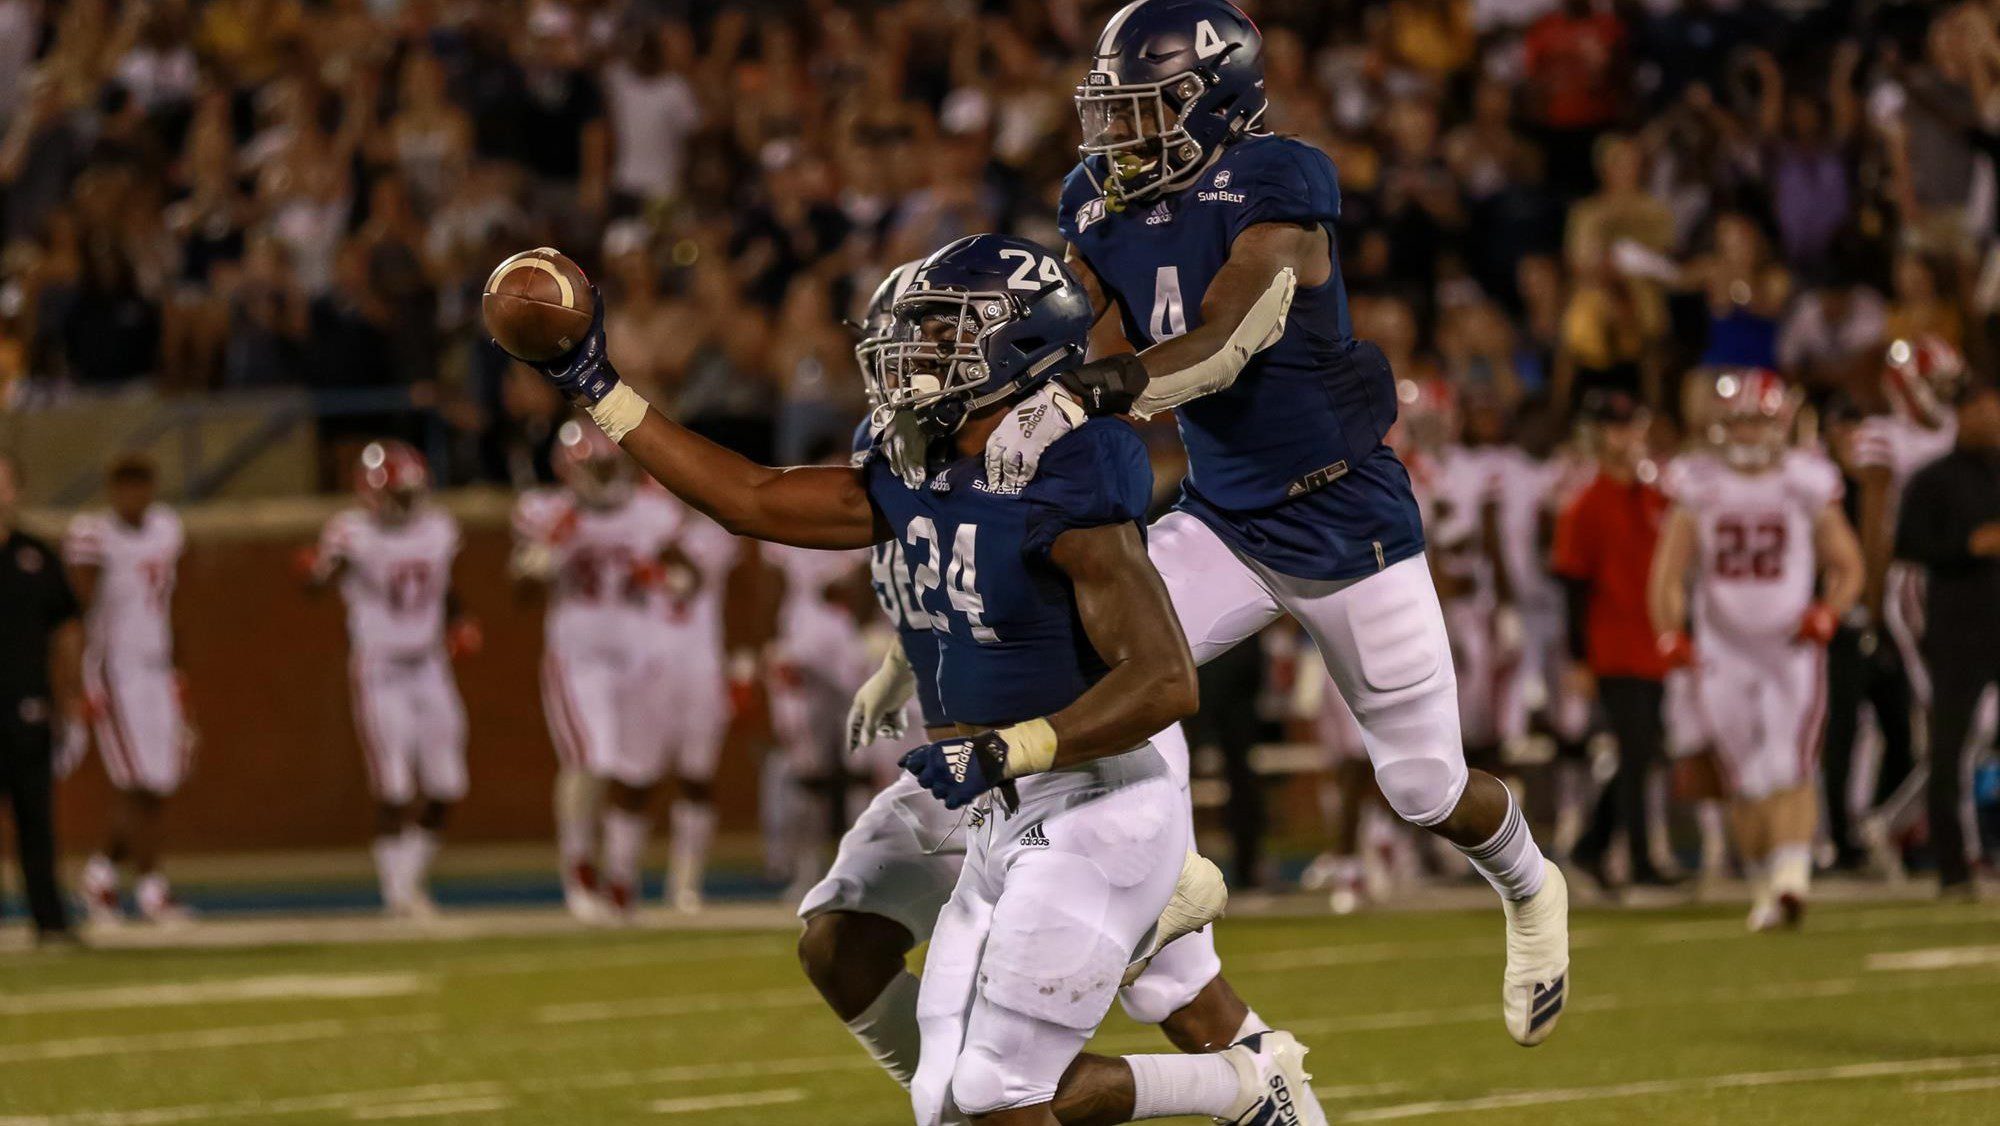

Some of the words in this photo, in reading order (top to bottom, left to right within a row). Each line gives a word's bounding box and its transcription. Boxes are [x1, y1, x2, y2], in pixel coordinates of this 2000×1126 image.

[1195, 19, 1231, 65] 4
[1198, 191, 1218, 201] SUN
[1219, 191, 1245, 203] BELT
[999, 249, 1068, 298] 24
[1150, 266, 1187, 344] 4
[1024, 403, 1048, 439] adidas
[1714, 513, 1787, 581] 22
[906, 515, 1001, 643] 24
[955, 741, 974, 783] adidas
[1020, 836, 1049, 846] adidas
[1269, 1075, 1299, 1126] idas
